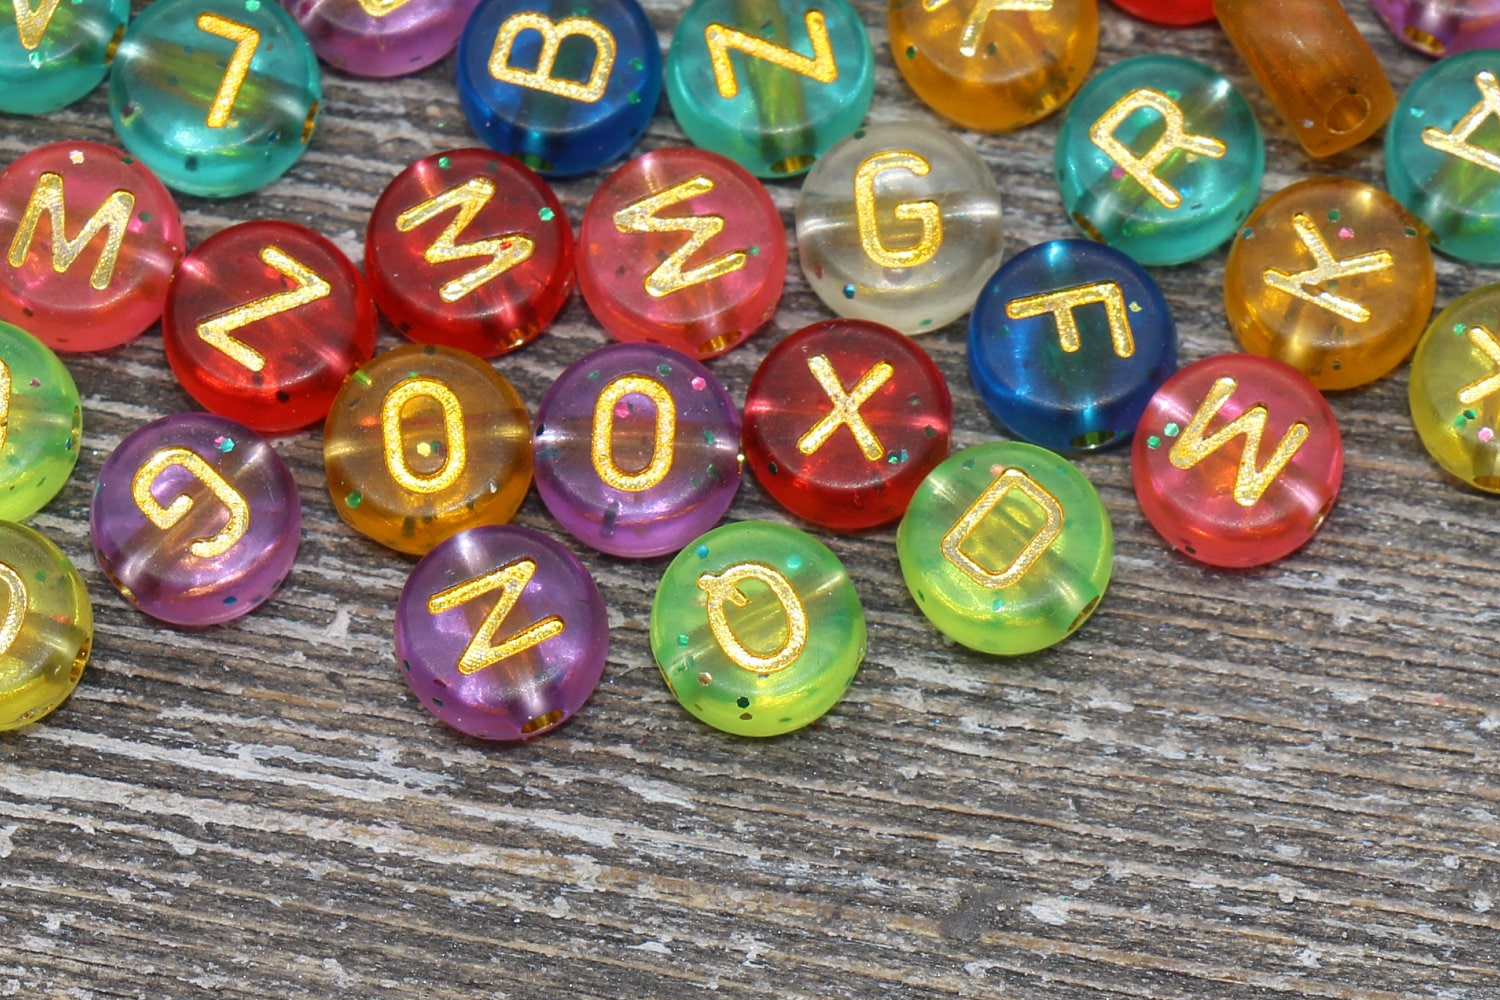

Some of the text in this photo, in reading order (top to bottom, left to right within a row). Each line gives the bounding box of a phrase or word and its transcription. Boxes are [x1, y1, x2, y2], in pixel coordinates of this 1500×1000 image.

[488, 11, 616, 102] B
[1089, 87, 1227, 209] R
[8, 172, 135, 290] M
[855, 150, 943, 268] G
[1006, 280, 1134, 358] F
[1263, 212, 1392, 323] K
[797, 353, 894, 462] X
[132, 446, 250, 559] G
[697, 561, 808, 674] Q
